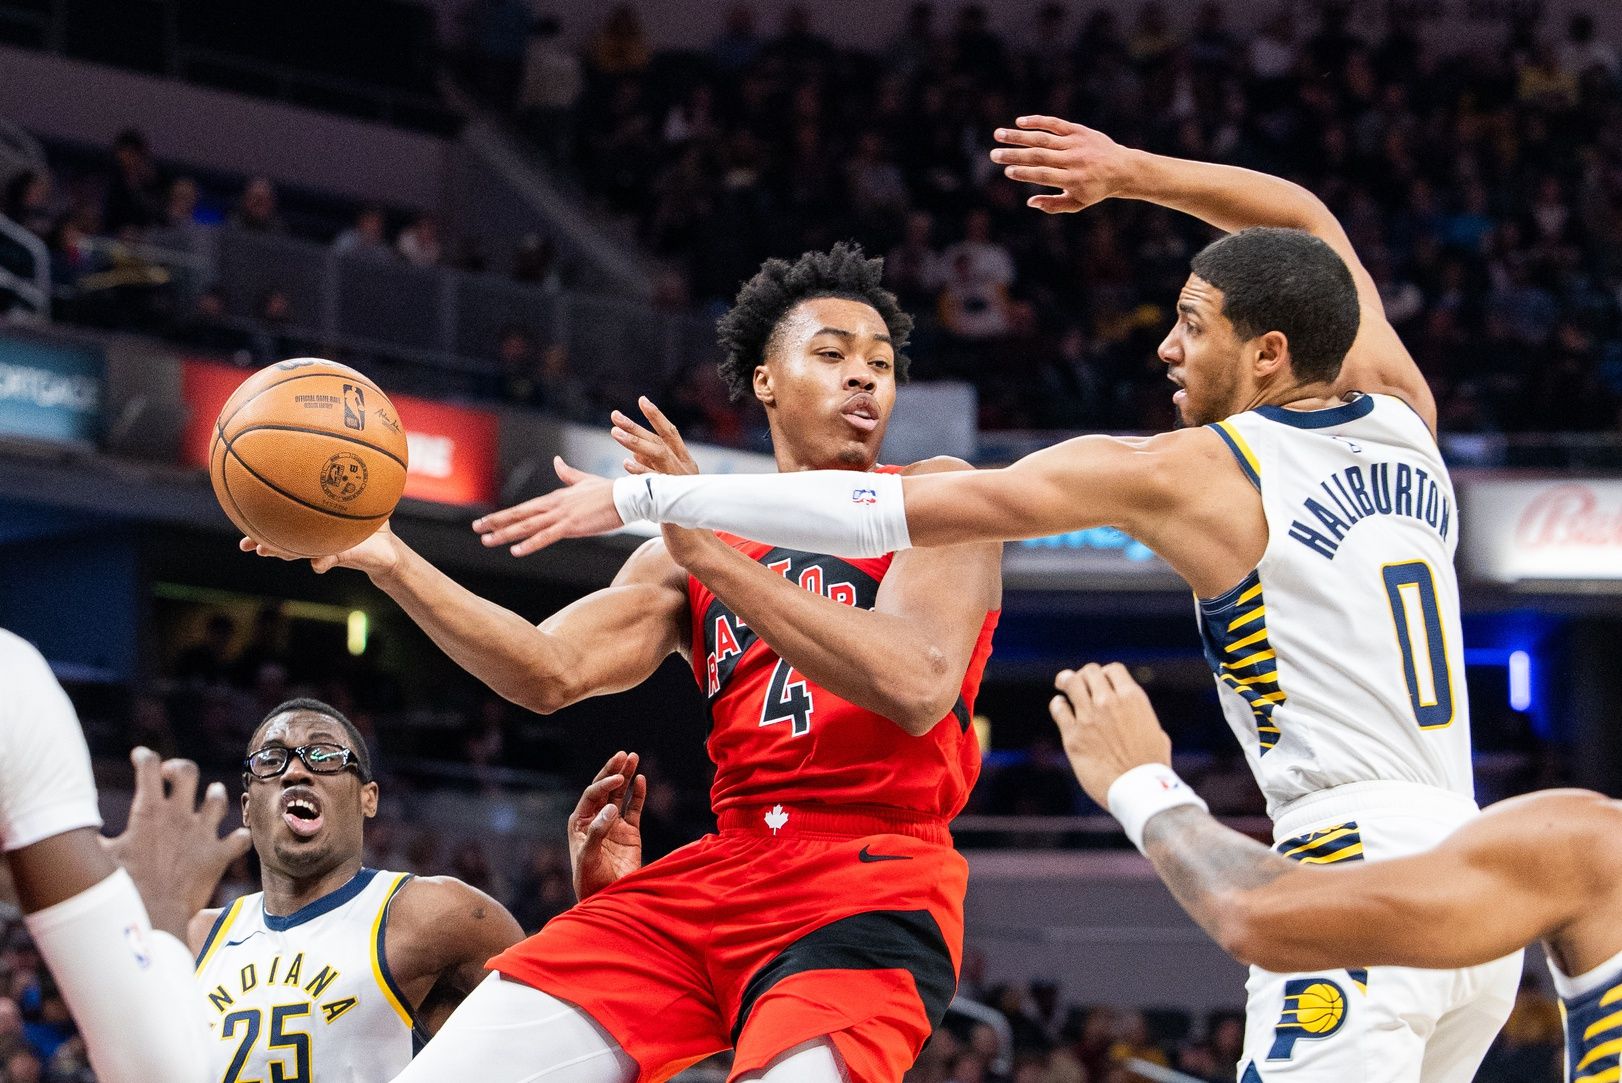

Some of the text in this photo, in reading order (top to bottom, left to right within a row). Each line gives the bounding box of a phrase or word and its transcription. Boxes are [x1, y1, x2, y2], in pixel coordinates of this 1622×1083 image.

[1288, 462, 1451, 561] HALIBURTON
[1380, 558, 1456, 731] 0
[758, 657, 815, 738] 4
[206, 951, 361, 1032] NDIANA
[220, 1001, 313, 1083] 25
